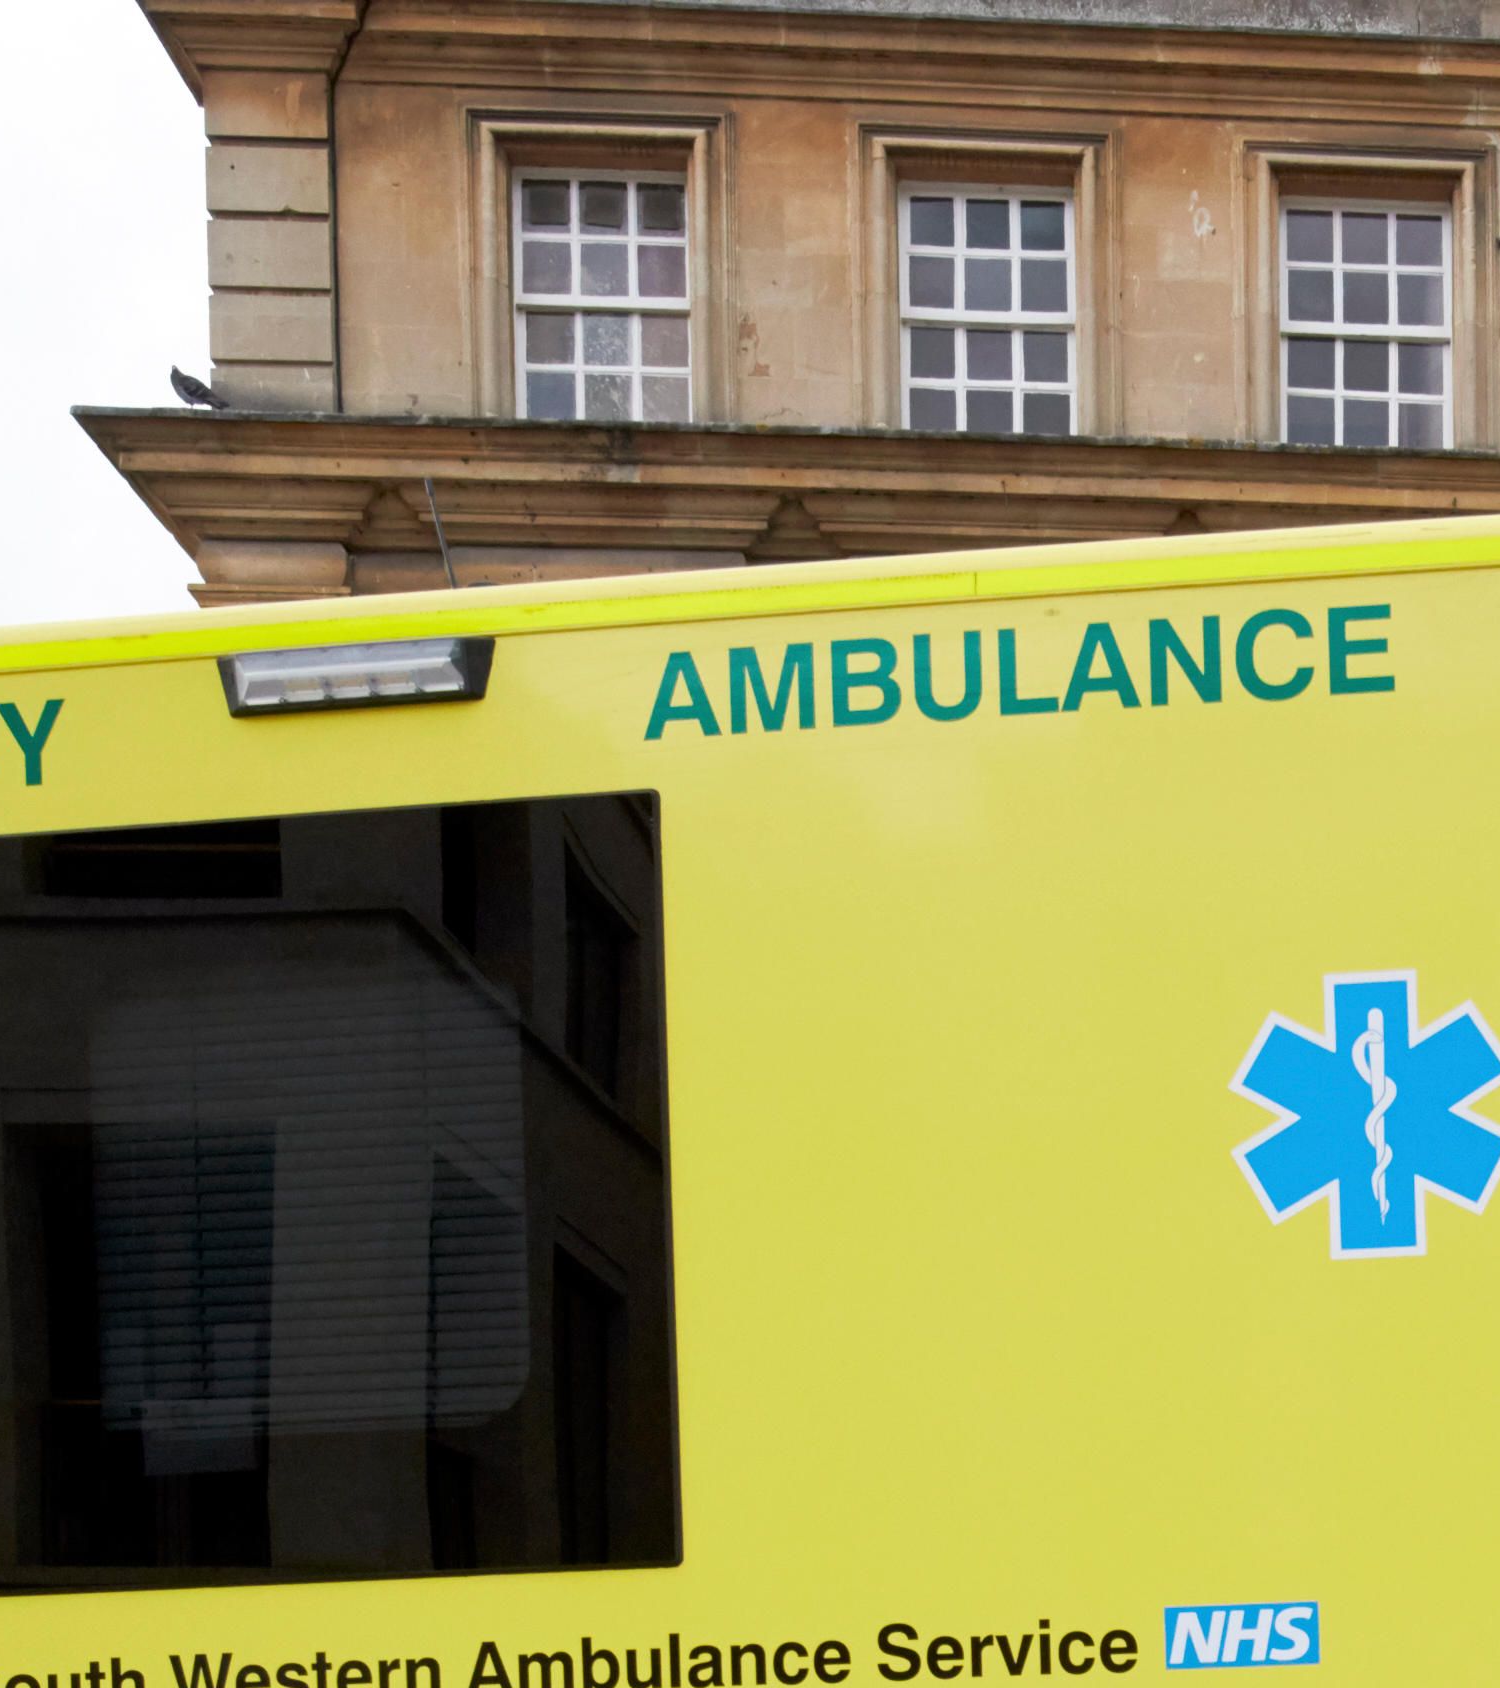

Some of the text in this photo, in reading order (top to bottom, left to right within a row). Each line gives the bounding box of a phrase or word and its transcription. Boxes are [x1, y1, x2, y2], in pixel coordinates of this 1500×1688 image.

[645, 604, 1395, 740] AMBULANCE
[877, 1619, 1139, 1683] Service
[1169, 1606, 1313, 1665] NHS
